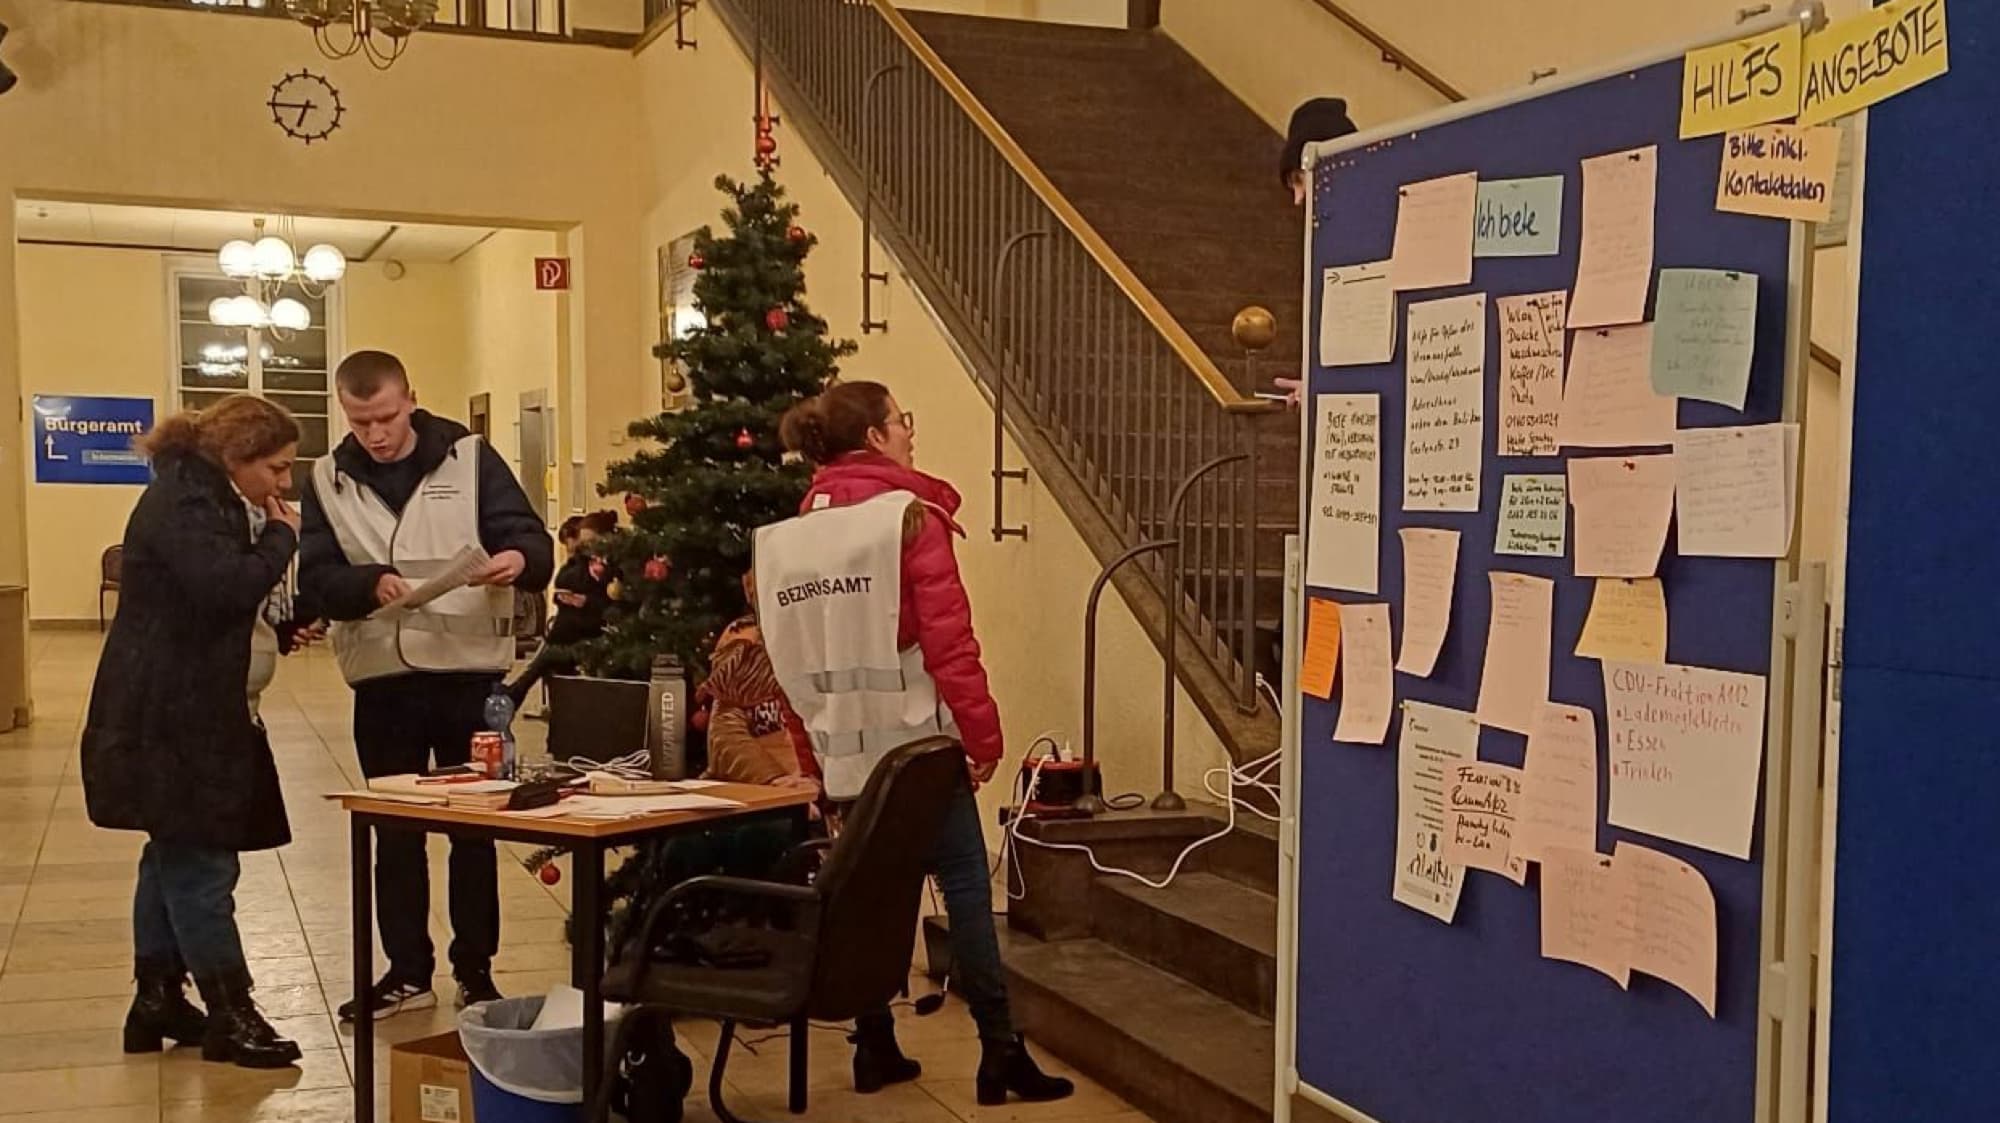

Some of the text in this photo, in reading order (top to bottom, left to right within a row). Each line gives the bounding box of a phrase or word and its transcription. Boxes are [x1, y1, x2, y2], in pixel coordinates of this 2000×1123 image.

[1694, 0, 1943, 113] HILFS ANGEBOTE
[1728, 131, 1808, 162] Bitte inkl.
[1724, 170, 1825, 203] Kontaktdaten
[1499, 201, 1540, 238] biete
[1627, 729, 1667, 751] Essen
